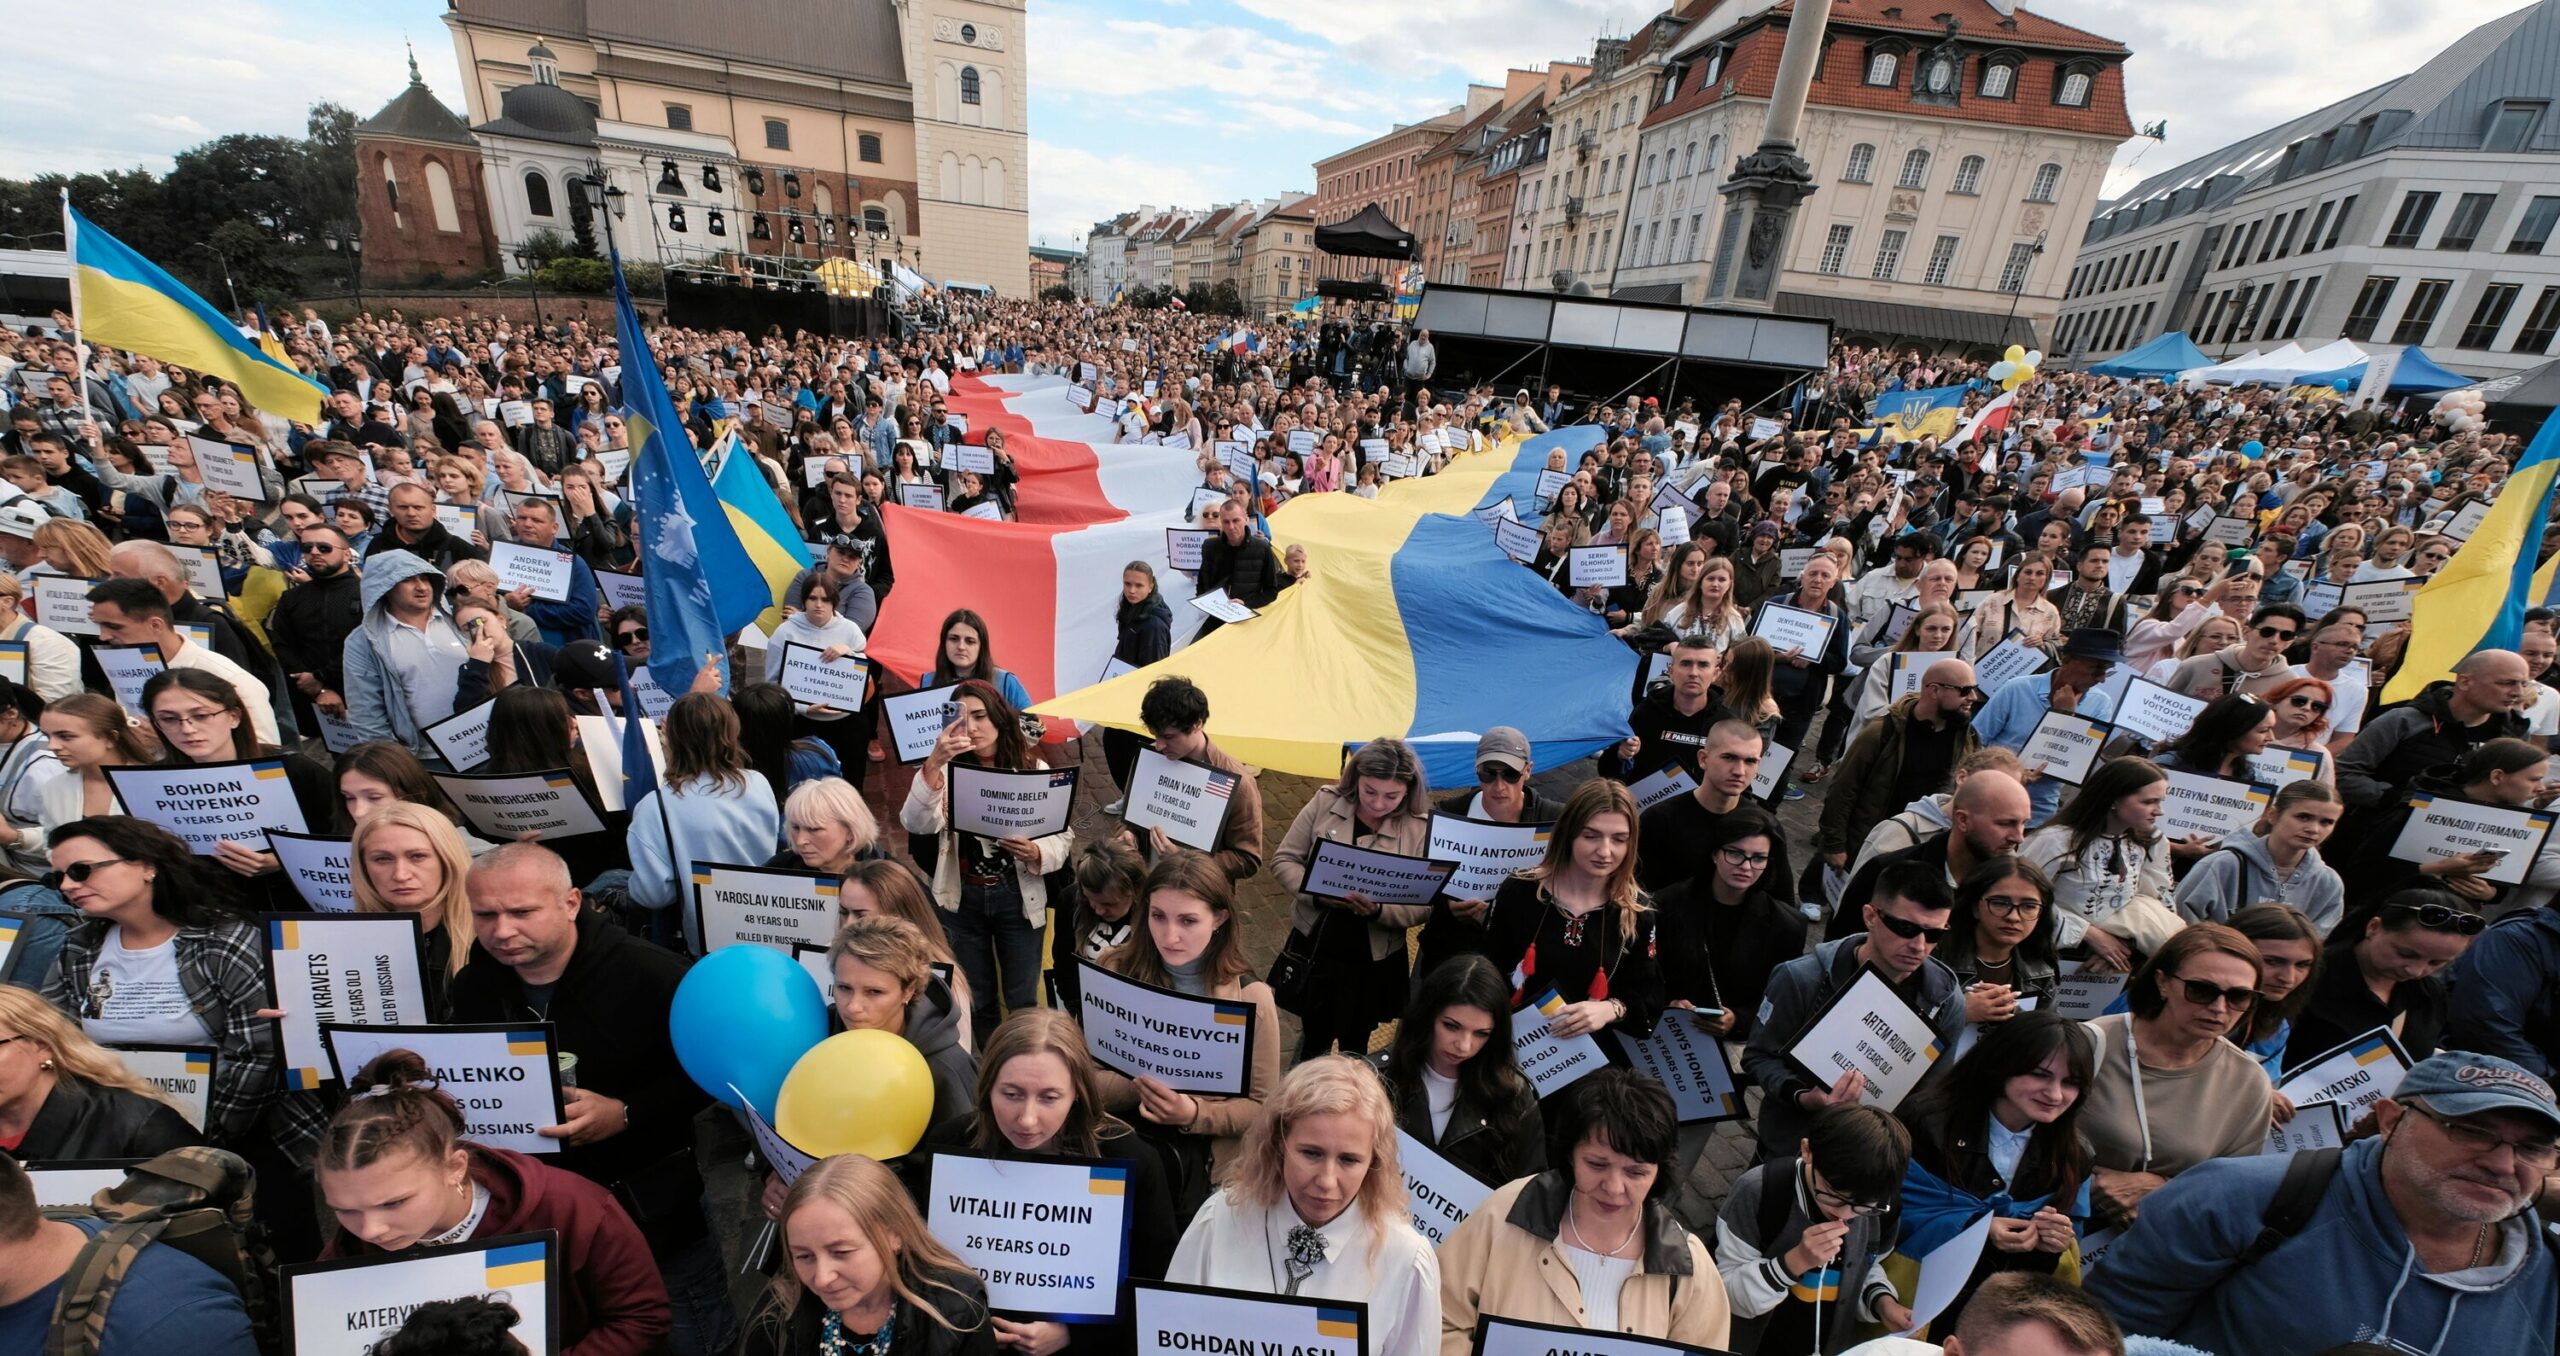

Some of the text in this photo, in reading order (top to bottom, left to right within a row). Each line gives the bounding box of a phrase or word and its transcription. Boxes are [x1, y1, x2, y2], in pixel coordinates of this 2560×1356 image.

[508, 562, 553, 577] BAGSHAW
[512, 555, 551, 569] ANDREW
[516, 572, 536, 582] YEARS
[537, 576, 551, 584] OLD
[1982, 648, 2009, 670] DARYNA
[1982, 648, 2020, 680] SYDORENKO
[787, 658, 864, 683] ARTEM YERASHOV
[804, 676, 844, 690] 5 YEARS OLD
[1907, 672, 1917, 691] ZIBER
[789, 684, 812, 694] KILLED
[822, 691, 854, 703] RUSSIANS
[2152, 693, 2193, 713] MYKOLA
[905, 707, 942, 722] MARIIA
[2127, 714, 2150, 729] KILLED
[2151, 711, 2174, 725] YEARS
[2174, 721, 2191, 731] OLD
[448, 722, 487, 744] SERHII
[917, 723, 943, 735] 15 YEA
[908, 739, 935, 751] KILLED
[462, 748, 486, 762] KILLE
[163, 780, 244, 797] BOHDAN
[980, 788, 1049, 802] DOMINIC ABELEN
[1157, 775, 1202, 799] BRIAN YANG
[1640, 781, 1683, 808] HAHARIN
[155, 794, 261, 812] PYLYPENKO
[494, 790, 560, 807] MISHCHENKO
[1153, 791, 1191, 811] 51 YEARS OLD
[2210, 794, 2255, 813] SMIRNOVA
[174, 811, 255, 825] 6 YEARS OLD
[505, 809, 532, 820] YEARS
[533, 808, 550, 819] OLD
[987, 804, 1035, 815] 31 YEARS OLD
[1146, 802, 1198, 829] KILLED BY RUSSIANS
[2182, 806, 2228, 822] 16 YEARS OLD
[495, 819, 568, 833] KILLED BY RUSSIANS
[981, 815, 1046, 828] KILLED BY RUSSIANS
[2167, 817, 2231, 837] KILLED BY RUSSIANS
[2424, 813, 2532, 841] HENNADII FURMANOV
[204, 833, 218, 842] BY
[221, 824, 289, 842] RUSSIS
[2444, 835, 2457, 844] 48
[2457, 836, 2483, 848] YEARS
[1433, 836, 1547, 859] VITALII ANTONIUK
[2427, 846, 2456, 858] KILLED
[299, 868, 351, 886] PEREH
[1318, 855, 1445, 883] OLEH YURCHENKO
[1468, 865, 1499, 876] YEARS
[1322, 879, 1420, 900] KILLED BY RUSSIANS
[1342, 873, 1410, 890] 48 YEARS OLD
[1472, 883, 1485, 891] BY
[320, 887, 332, 897] 14
[715, 889, 826, 912] YAROSLAV KOLIESNIK
[744, 914, 799, 929] 48 YEARS OLD
[735, 931, 812, 945] KILLED BY RUSSIANS
[308, 953, 334, 1009] KRAVETS
[375, 954, 396, 1011] BY RUSSIANS
[345, 969, 366, 1018] YEARS OLD
[1083, 991, 1240, 1044] ANDRII YUREVYCH
[1114, 1028, 1201, 1061] 52 YEARS OLD
[1862, 1010, 1917, 1065] ARTEM RUDYKA
[1098, 1038, 1224, 1081] KILLED BY RUSSIANS
[1536, 1045, 1559, 1062] OLD
[1646, 1054, 1655, 1067] BY
[1664, 1016, 1716, 1105] DENYS HONETS
[1831, 1049, 1855, 1072] KILLED
[1855, 1039, 1893, 1076] 19 YEARS OLD
[432, 1066, 526, 1083] ALENKO
[1535, 1051, 1588, 1084] RUSSIANS
[1660, 1041, 1679, 1072] YEARS
[1672, 1069, 1688, 1093] OLD
[2321, 1068, 2372, 1099] YATSKO
[470, 1098, 503, 1110] OLD
[949, 1195, 1093, 1225] VITALII FOMIN
[1427, 1226, 1446, 1245] OL
[966, 1235, 1071, 1257] 26 YEARS OLD
[992, 1270, 1012, 1285] BY
[1015, 1272, 1096, 1290] RUSSIANS
[346, 1303, 421, 1331] KATERYN
[1158, 1329, 1255, 1356] BOHDAN
